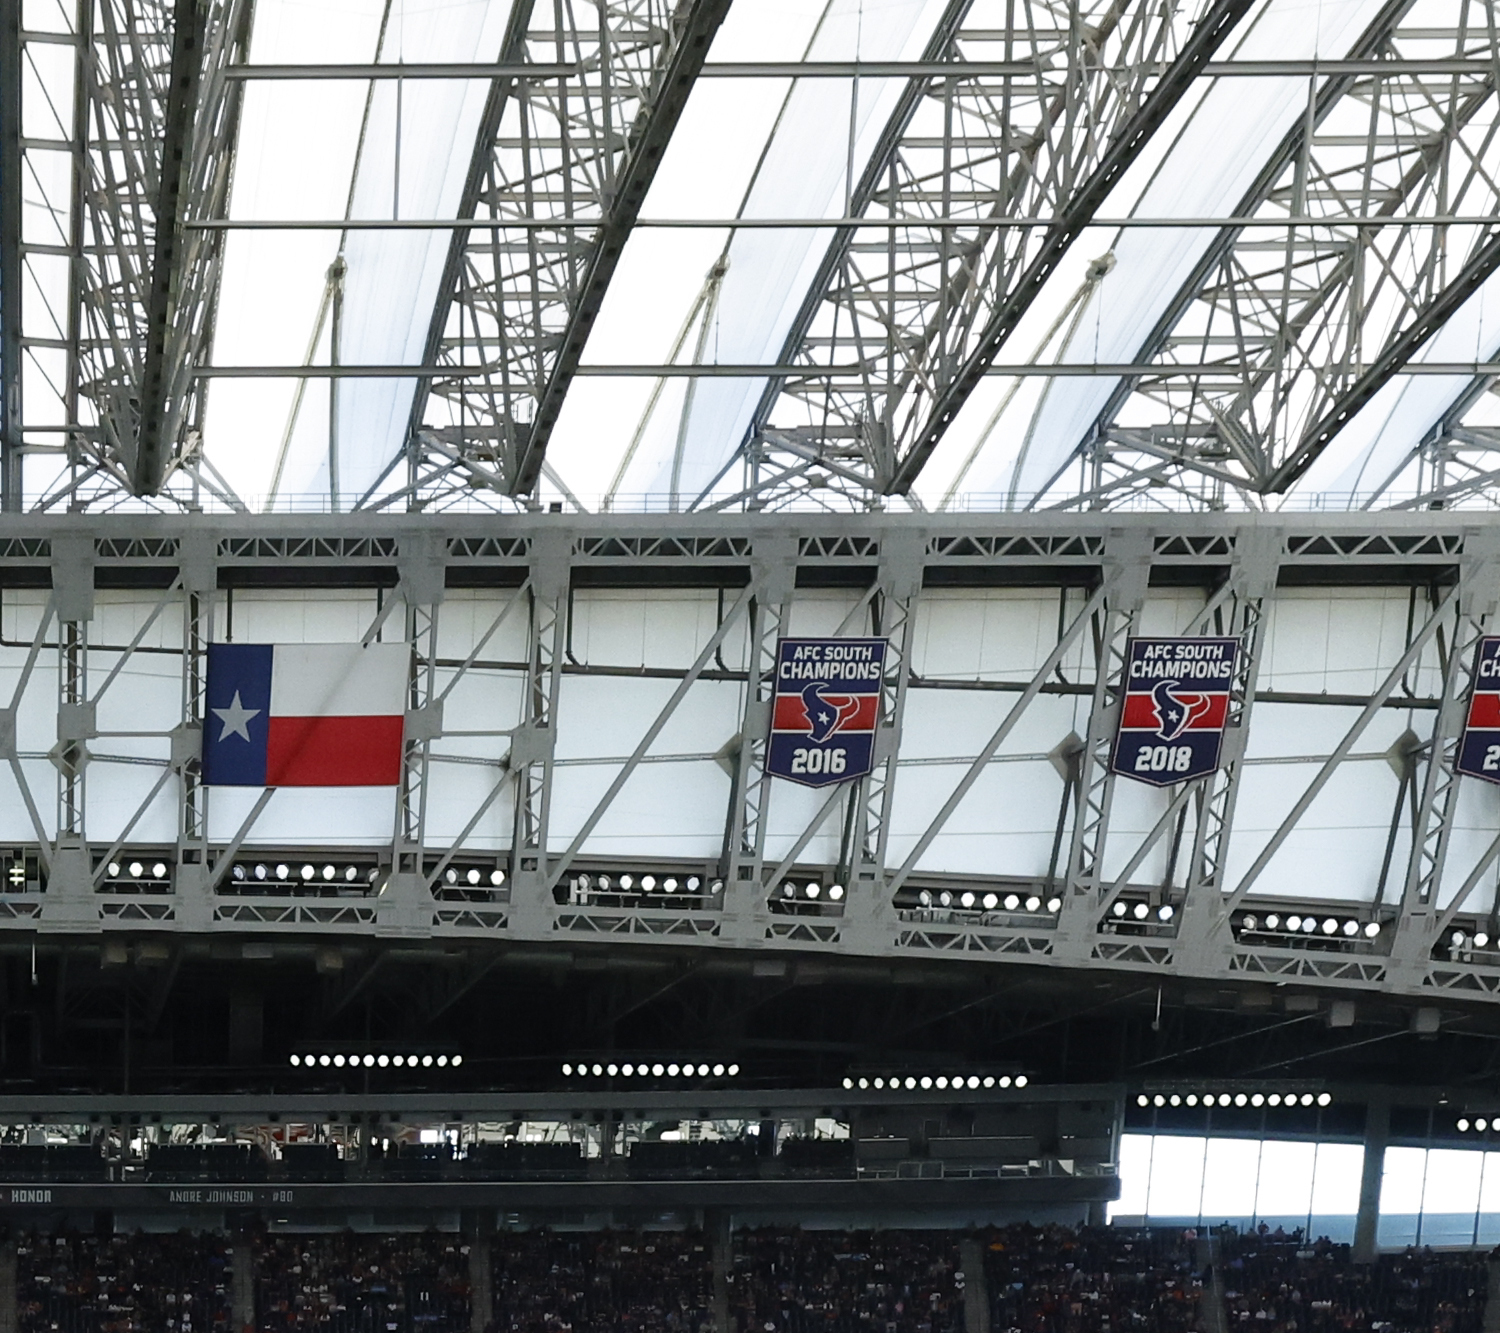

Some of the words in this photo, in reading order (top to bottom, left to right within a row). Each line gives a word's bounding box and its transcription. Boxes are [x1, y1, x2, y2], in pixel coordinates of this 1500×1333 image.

[795, 645, 822, 663] AFC
[824, 645, 874, 662] SOUTH
[1143, 643, 1172, 661] AFC
[1174, 643, 1225, 661] SOUTH
[780, 660, 883, 682] CHAMPIONS
[1130, 659, 1234, 681] CHAMPIONS
[791, 747, 848, 776] 2016
[1135, 744, 1193, 774] 2018
